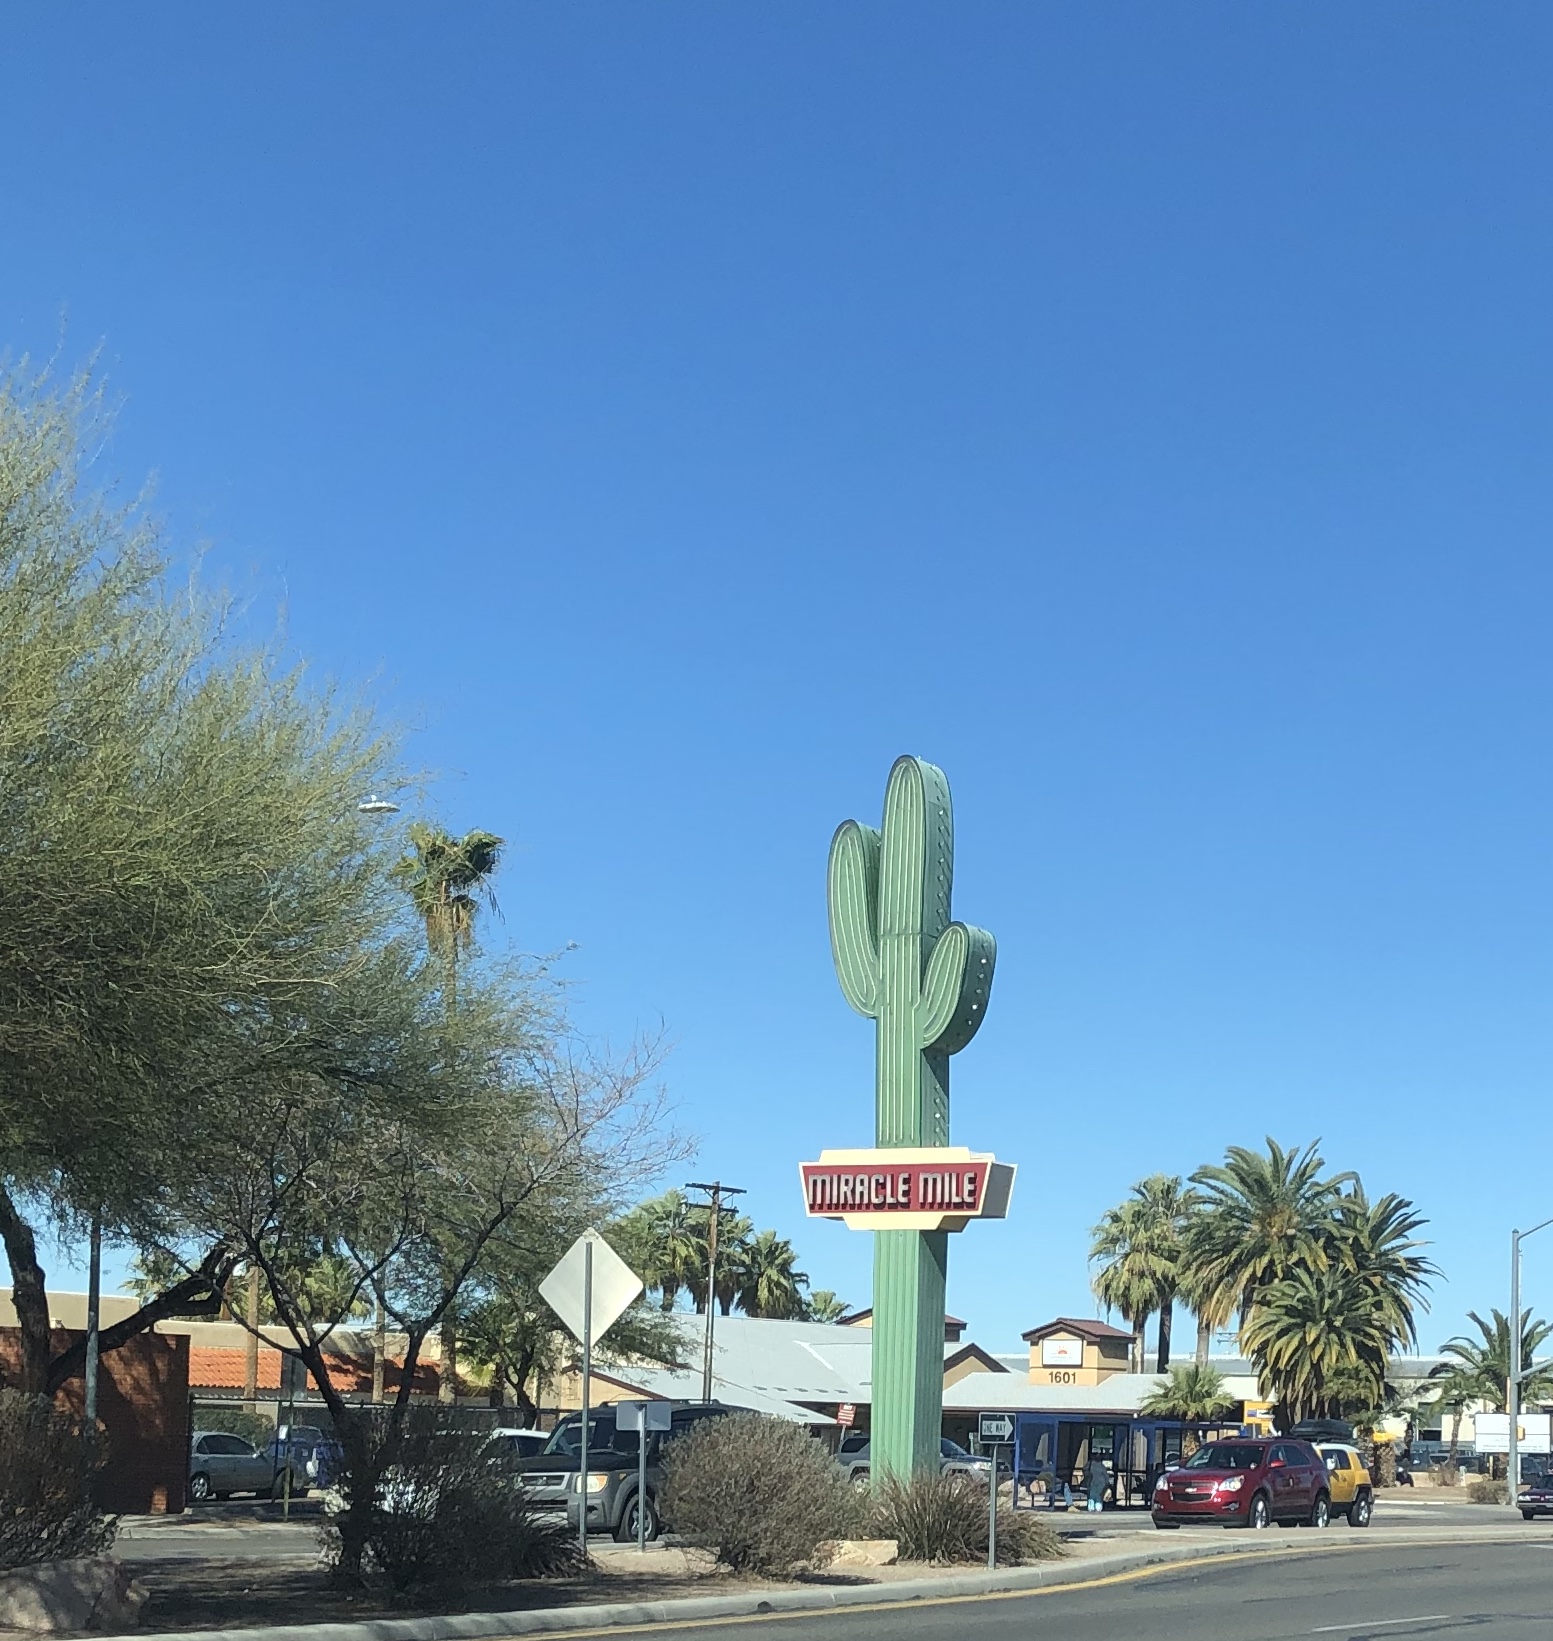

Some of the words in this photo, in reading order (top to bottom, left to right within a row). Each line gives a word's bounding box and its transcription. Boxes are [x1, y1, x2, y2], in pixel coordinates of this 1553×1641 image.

[808, 1172, 910, 1207] MIRACLE
[918, 1172, 976, 1206] MILE
[1048, 1371, 1076, 1384] 1601
[995, 1422, 1007, 1434] WAY
